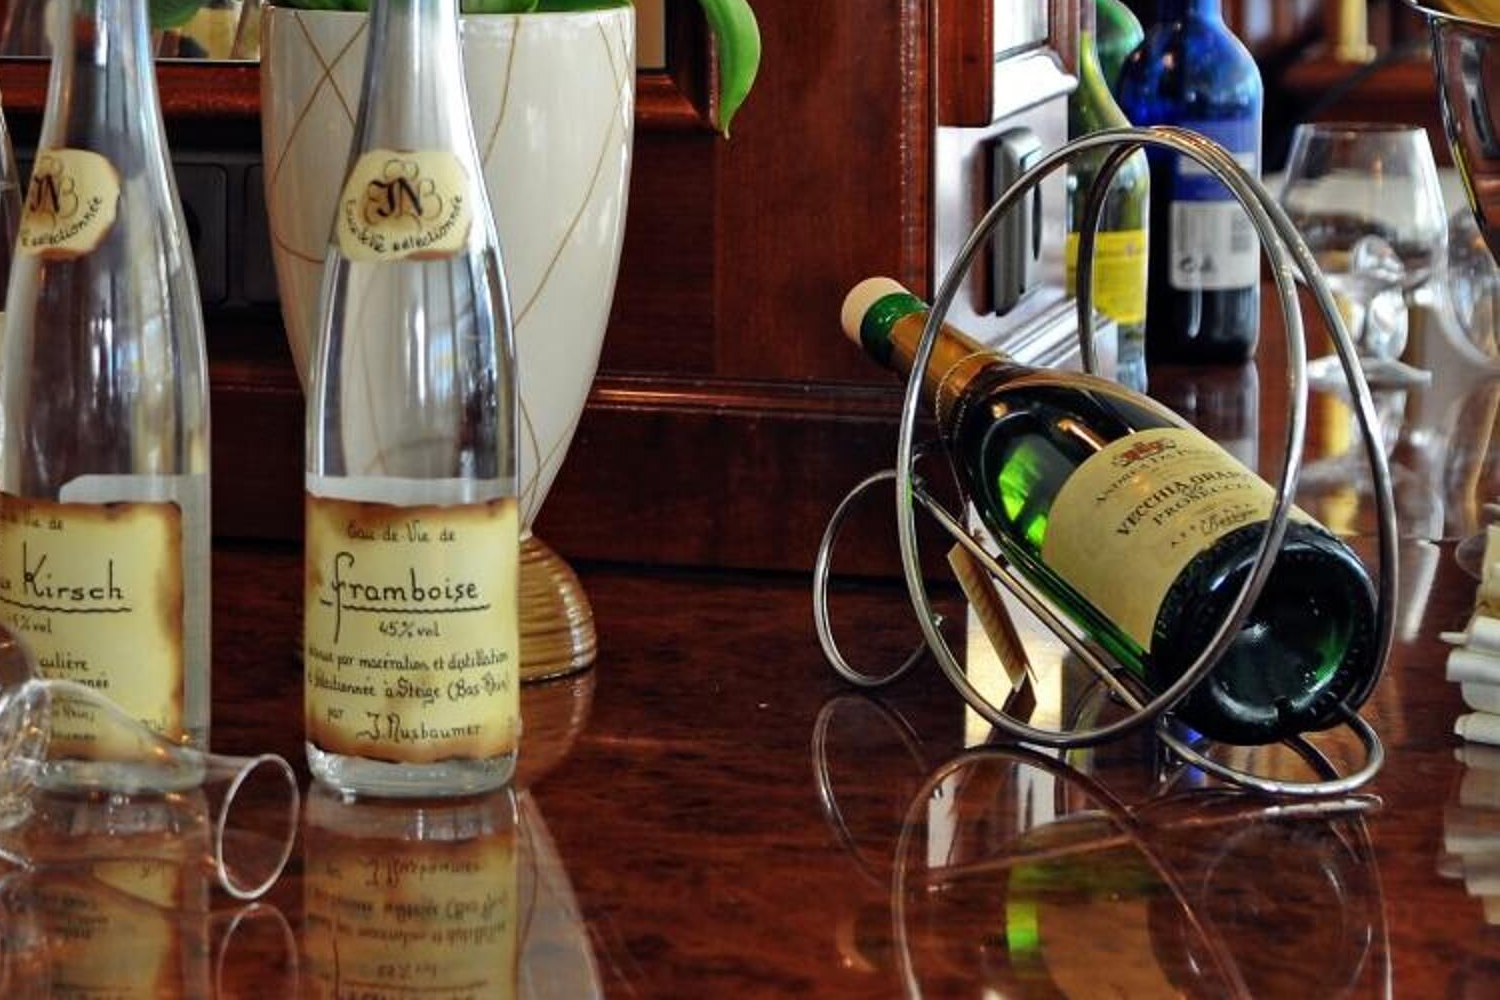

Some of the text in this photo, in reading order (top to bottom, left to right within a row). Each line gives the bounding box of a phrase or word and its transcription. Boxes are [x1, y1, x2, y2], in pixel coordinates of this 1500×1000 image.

[1115, 481, 1188, 536] VECCHIA
[404, 520, 430, 543] Vie
[439, 527, 456, 543] de
[22, 540, 125, 602] Kirsch
[388, 712, 483, 743] Nusbaumer
